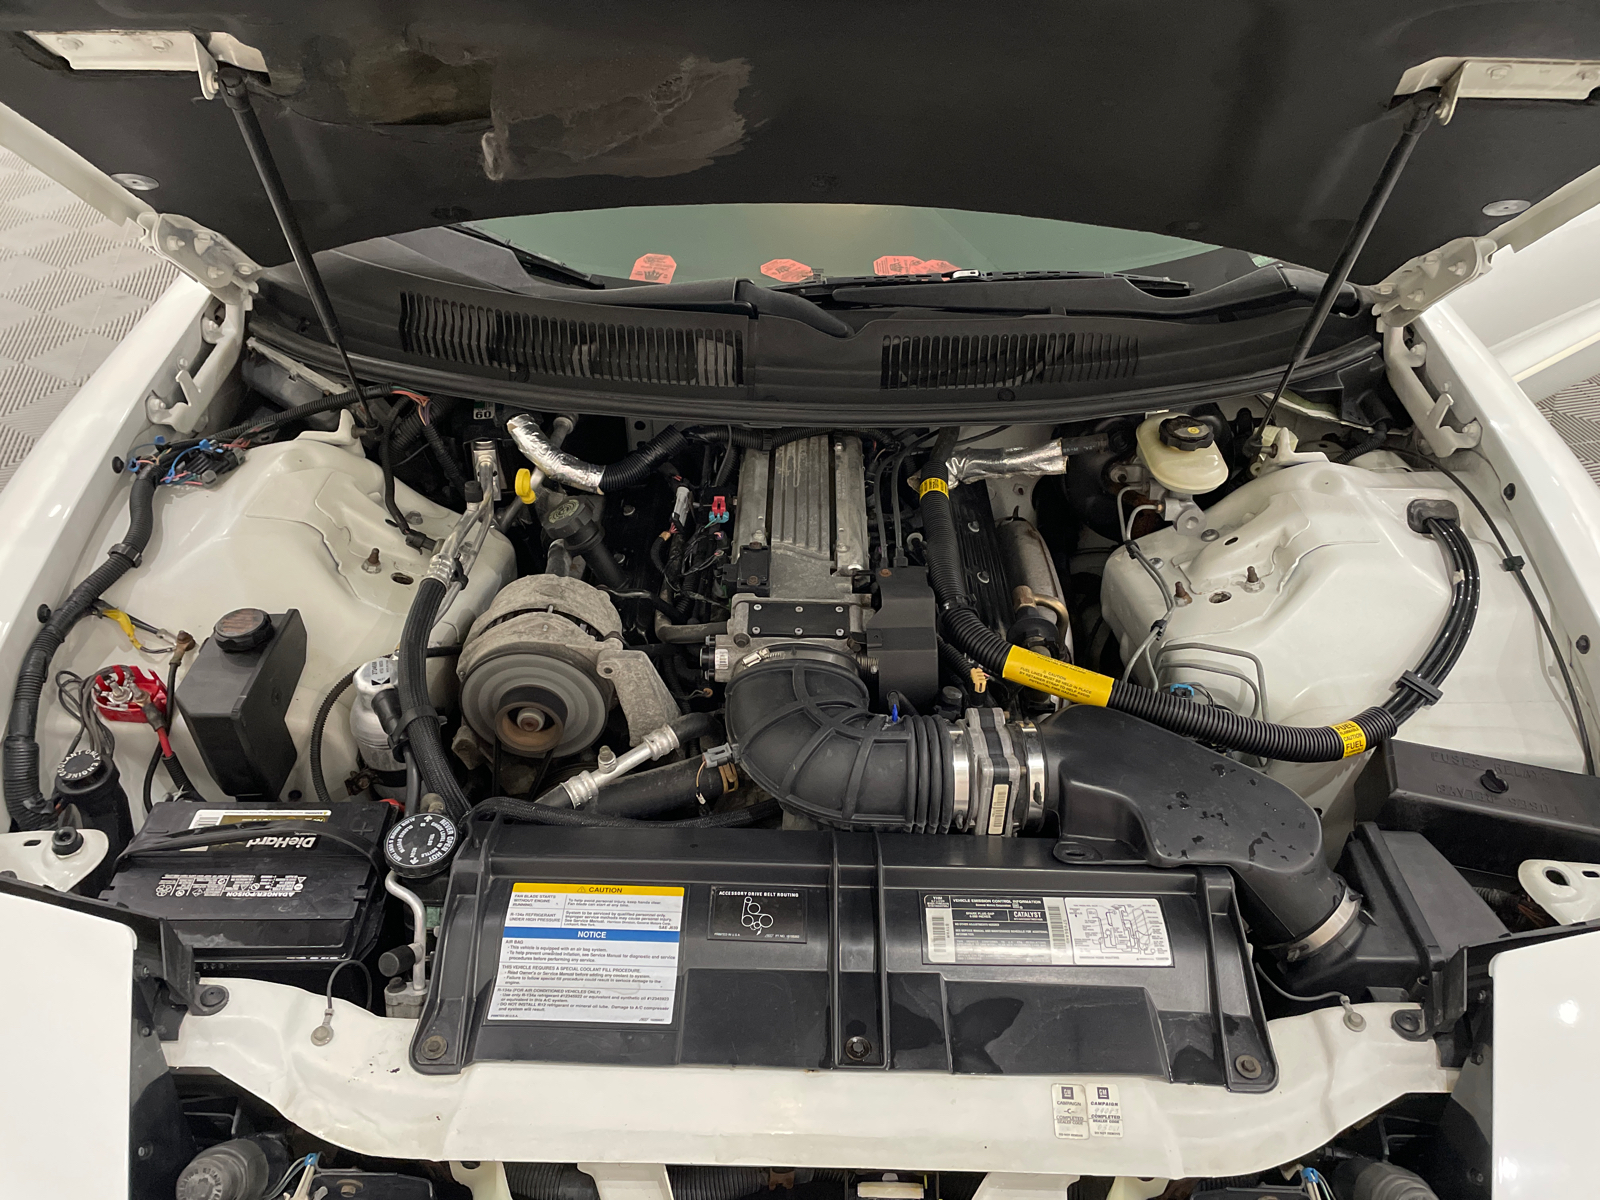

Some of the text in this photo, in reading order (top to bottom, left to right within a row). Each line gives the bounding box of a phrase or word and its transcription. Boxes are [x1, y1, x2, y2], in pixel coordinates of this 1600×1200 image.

[1335, 723, 1356, 731] FUEL
[1343, 732, 1362, 741] CAUTION
[1346, 740, 1363, 750] FUEL
[58, 750, 100, 776] COOLANT ONLY
[66, 762, 99, 778] ENGINE
[1431, 752, 1550, 780] FUSES RELAYS
[439, 818, 454, 835] NEVER
[246, 836, 316, 848] DieHard
[441, 836, 454, 852] OPEN
[429, 851, 442, 862] HOT
